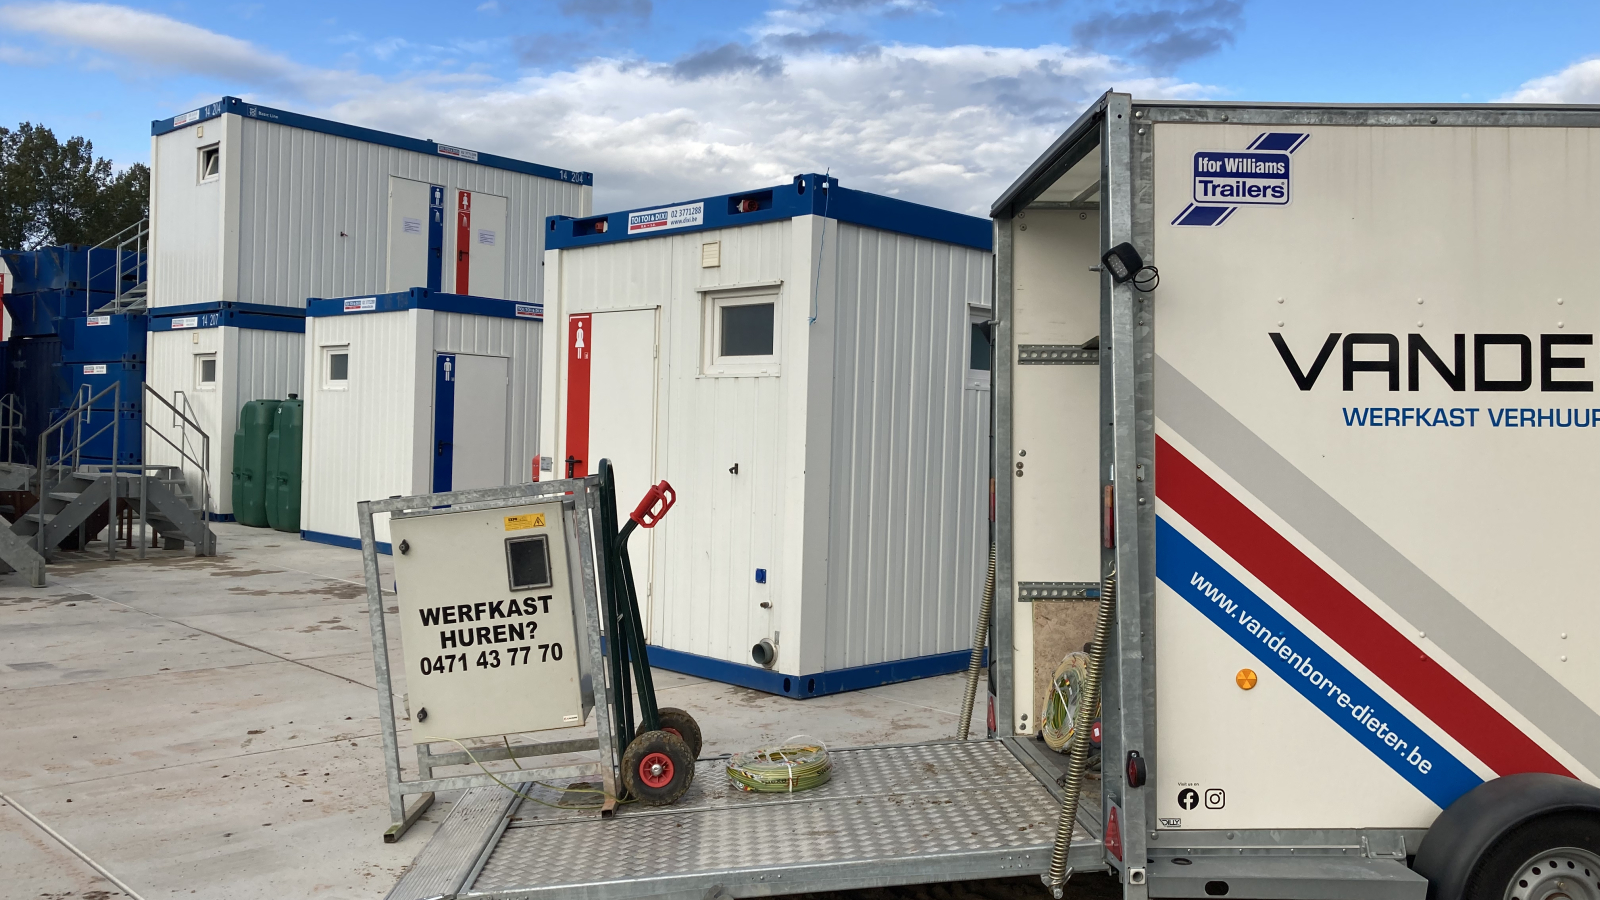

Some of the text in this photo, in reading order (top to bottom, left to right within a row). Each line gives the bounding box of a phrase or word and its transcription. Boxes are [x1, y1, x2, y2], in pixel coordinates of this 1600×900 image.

[1198, 157, 1285, 174] Ifor Williams
[559, 170, 583, 183] 14 204
[1198, 180, 1285, 199] Trailers
[670, 206, 702, 218] 02 3771288
[670, 216, 697, 225] www.dixi.be
[201, 314, 208, 327] 14
[209, 313, 219, 326] 207
[1268, 332, 1594, 392] VANDE
[1342, 407, 1480, 427] WERFKAST
[418, 594, 553, 627] WERFKAST
[440, 621, 538, 649] HUREN?
[420, 642, 563, 676] 0471 43 77 70
[1189, 571, 1432, 775] www.vandenborre-dieter.be
